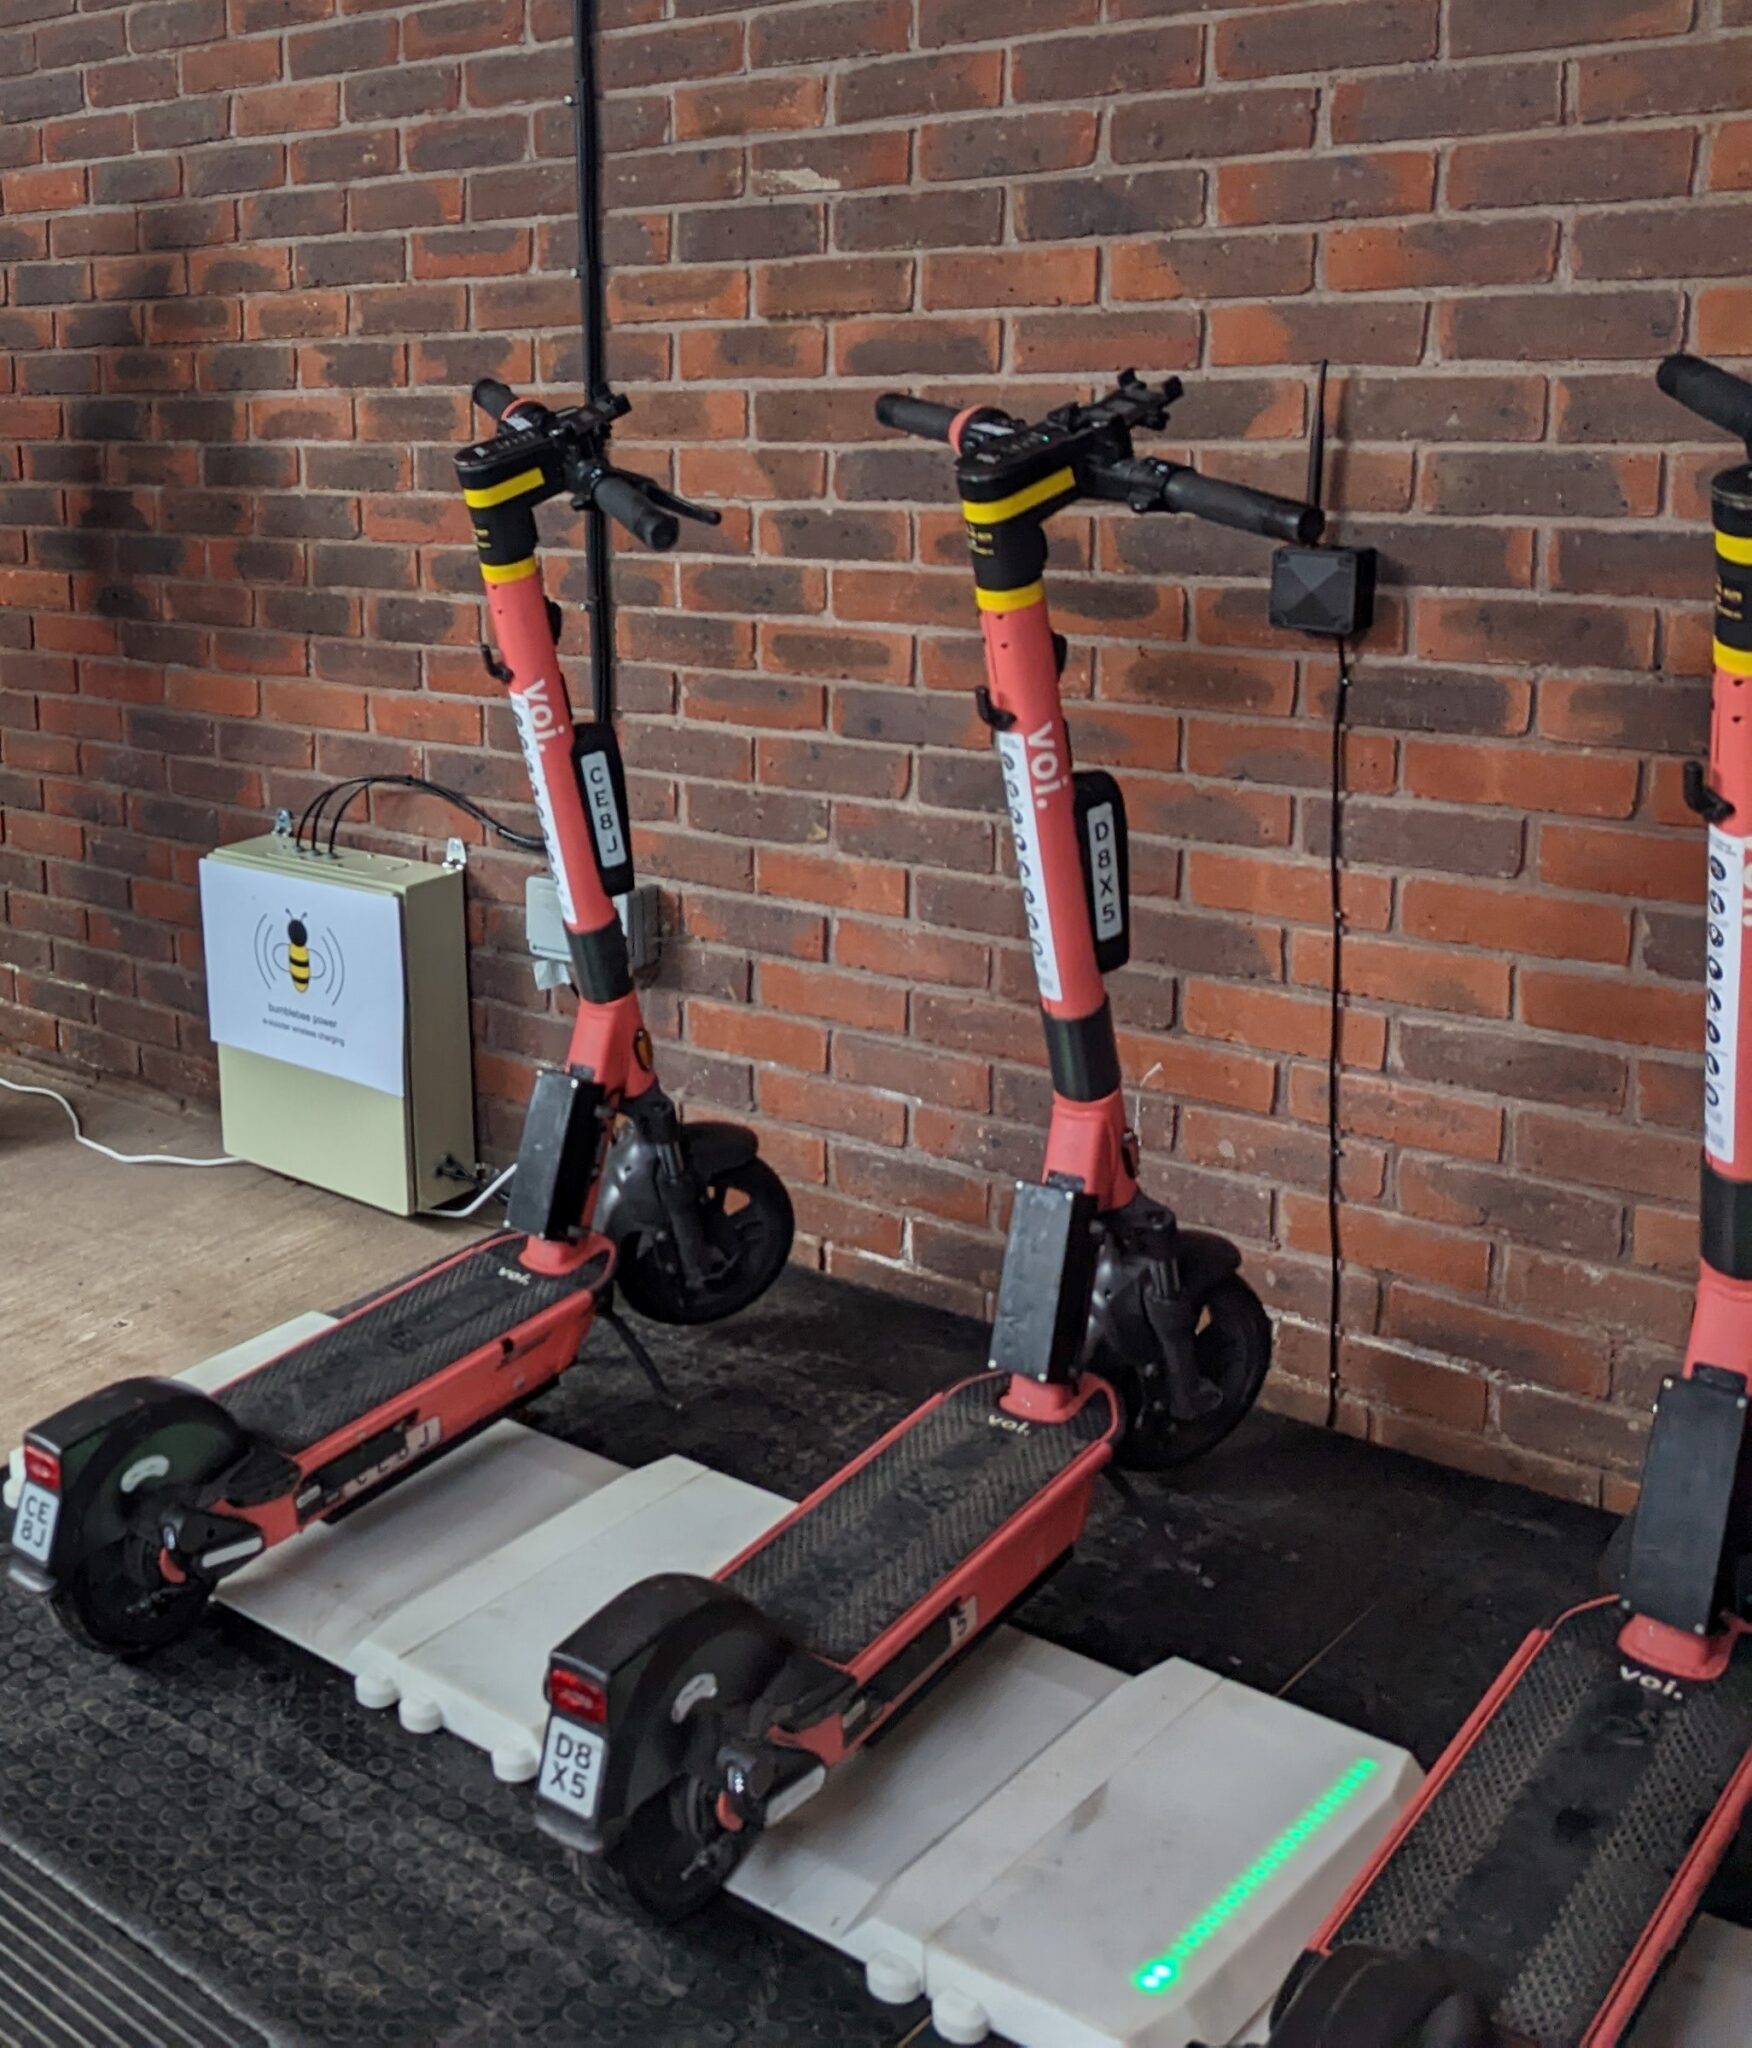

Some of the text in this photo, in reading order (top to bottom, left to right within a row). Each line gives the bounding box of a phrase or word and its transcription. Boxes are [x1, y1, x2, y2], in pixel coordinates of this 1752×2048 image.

[522, 678, 565, 752] voi.
[1027, 719, 1070, 811] voi.
[589, 766, 619, 854] CE8J
[1094, 821, 1116, 924] D8X5
[267, 1002, 338, 1028] bumblebee power
[25, 1495, 51, 1525] CE
[20, 1520, 46, 1548] 8J
[1620, 1664, 1683, 1700] voi.
[555, 1732, 593, 1770] D8
[549, 1760, 588, 1800] X5
